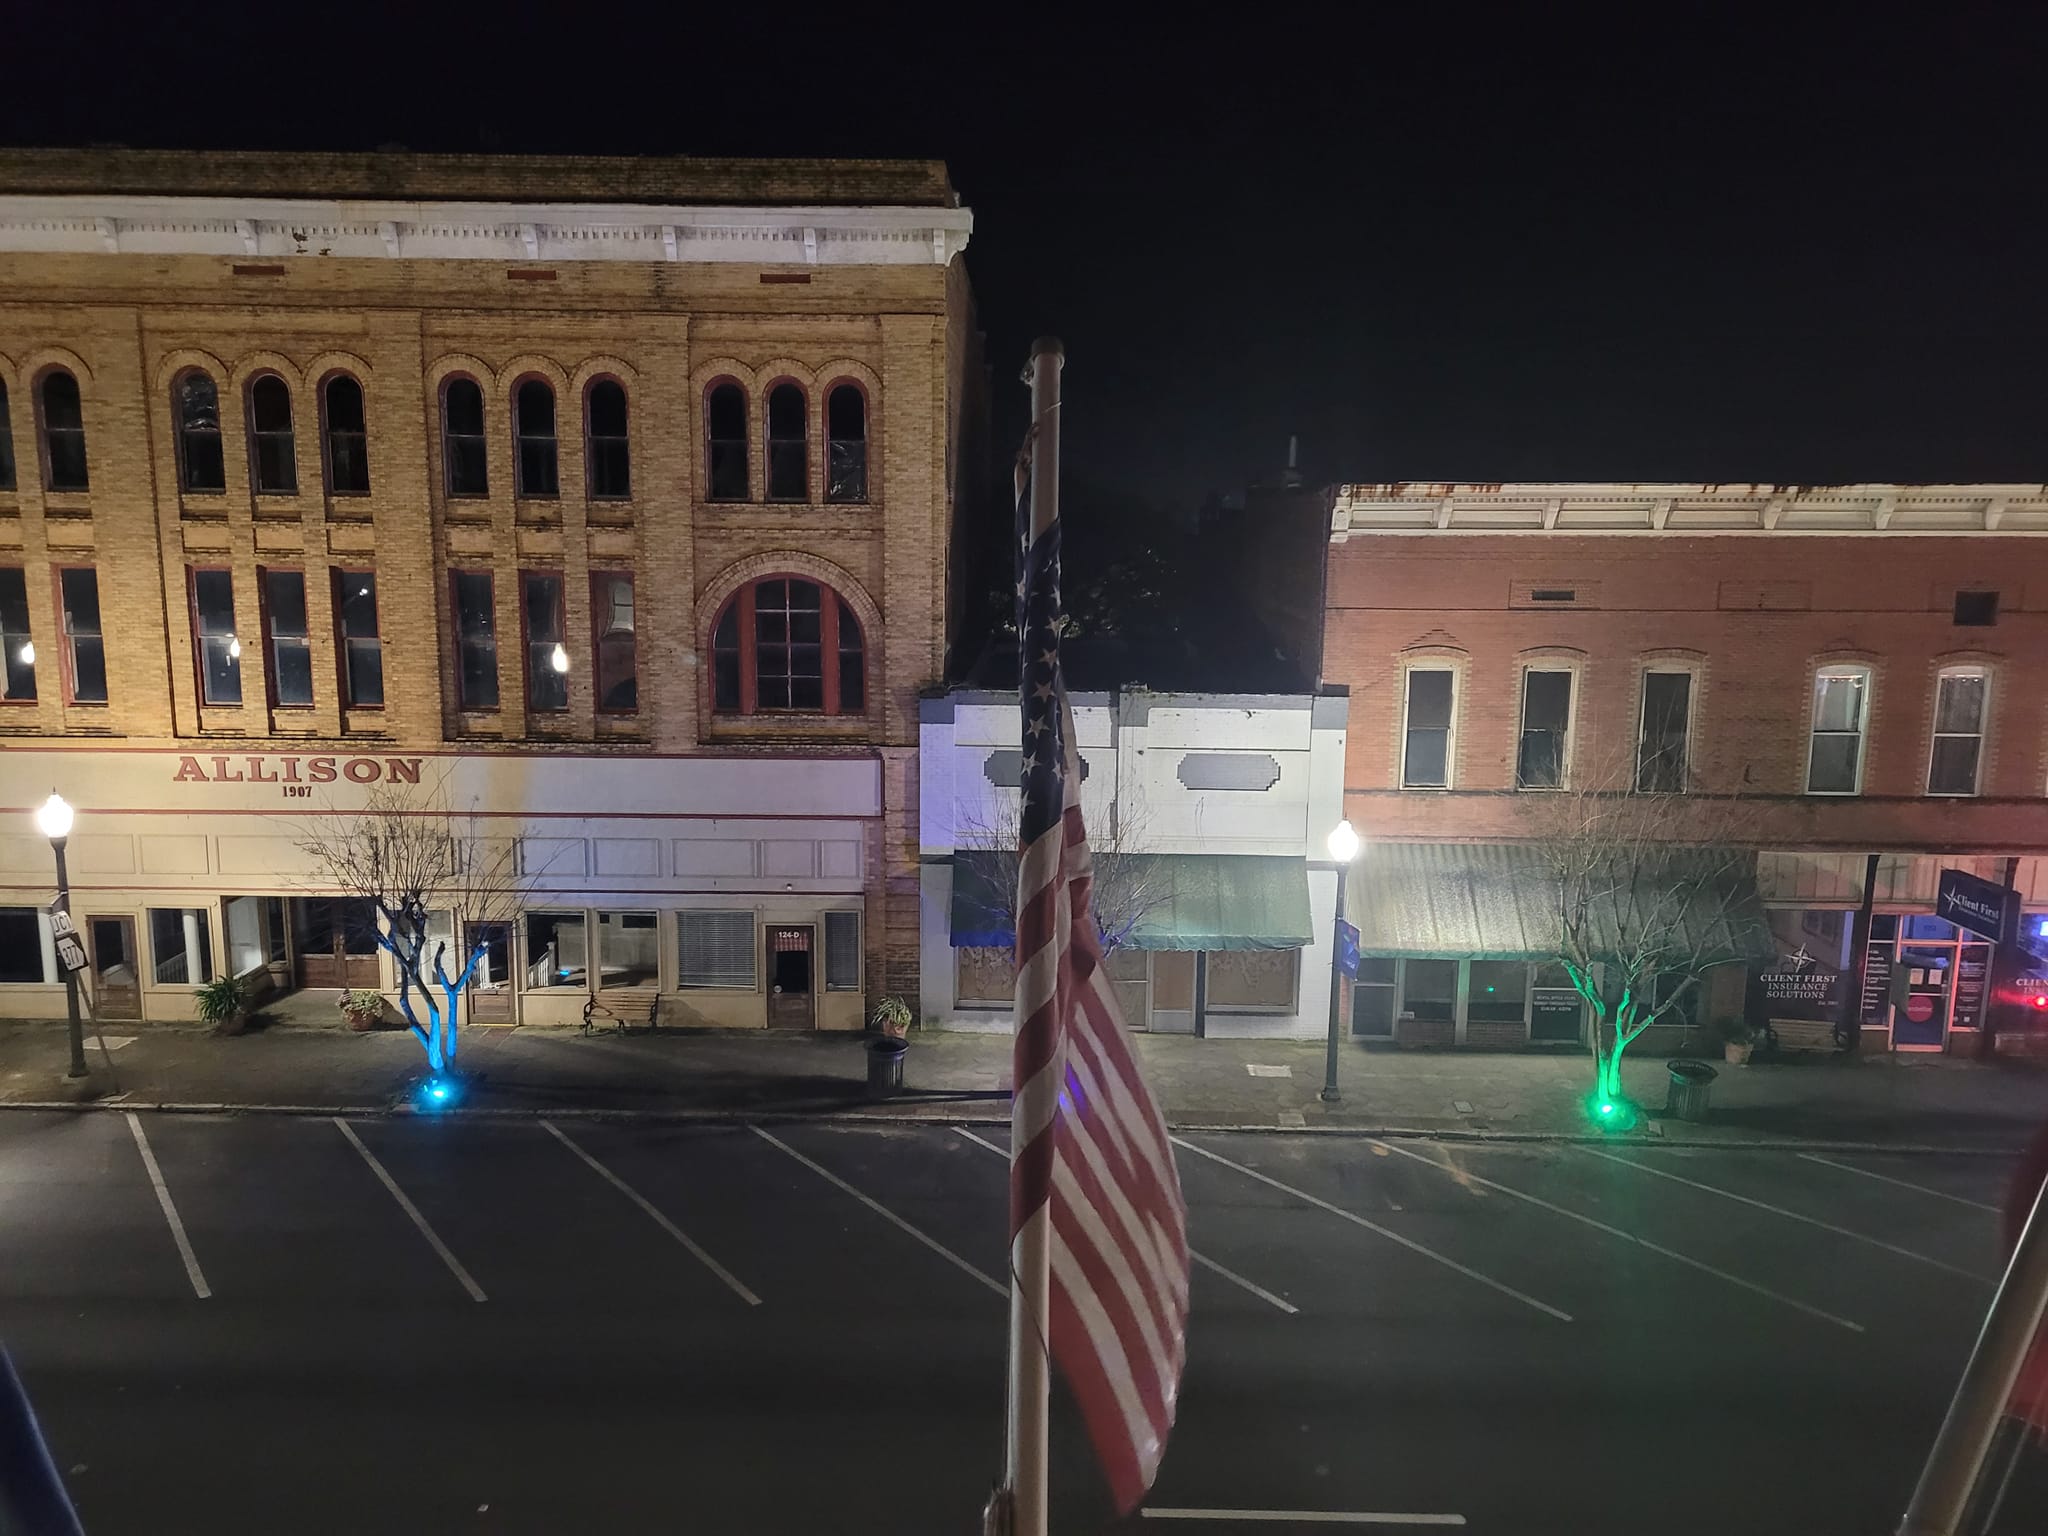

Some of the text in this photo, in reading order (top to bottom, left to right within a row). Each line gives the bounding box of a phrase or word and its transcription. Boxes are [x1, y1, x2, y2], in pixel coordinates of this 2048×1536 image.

[173, 756, 423, 784] ALLISON
[282, 785, 312, 798] 1907
[1957, 894, 1979, 912] Client
[1980, 903, 2000, 920] First
[62, 944, 80, 966] 377
[1760, 974, 1838, 983] CLIENT FIRST
[2015, 978, 2048, 987] CLIEN
[1768, 982, 1828, 991] INSURANCE
[1766, 990, 1825, 999] SOLUTIONS
